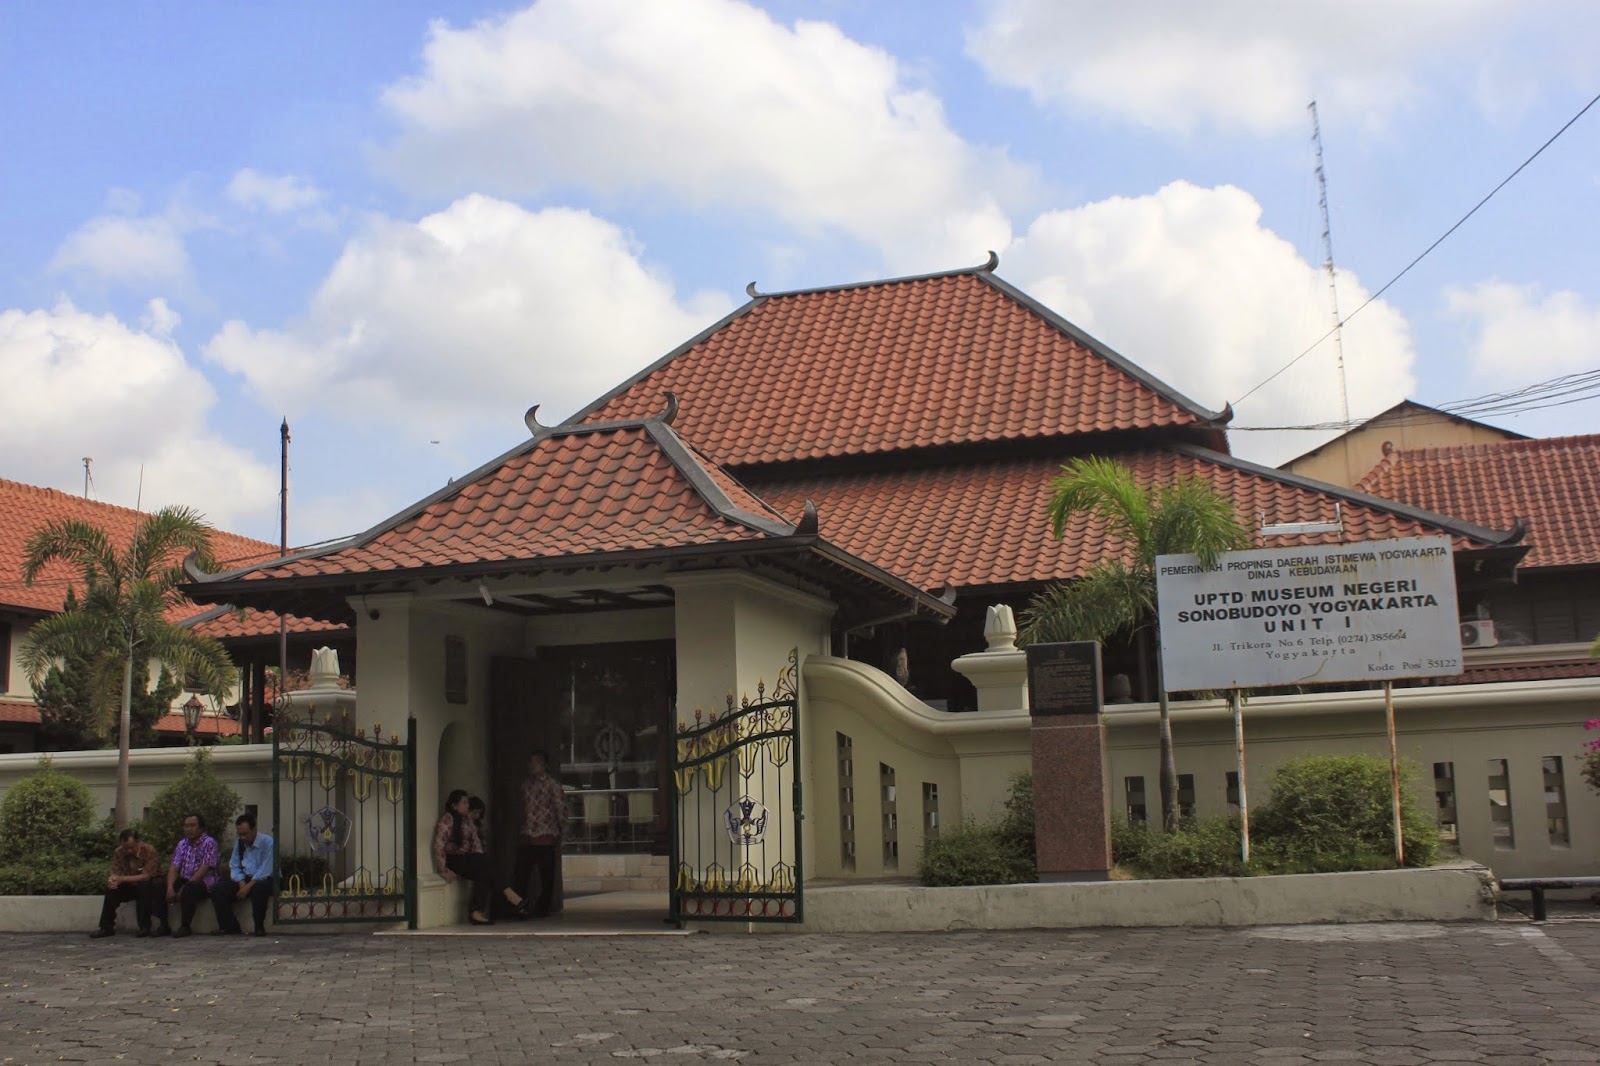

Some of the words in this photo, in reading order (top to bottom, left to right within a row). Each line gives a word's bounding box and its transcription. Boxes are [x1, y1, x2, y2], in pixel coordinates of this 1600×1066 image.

[1161, 563, 1222, 576] PEMERINAH
[1227, 559, 1273, 572] PROPINSI
[1277, 556, 1319, 568] DAERAH
[1325, 552, 1377, 564] ISTIMEWA
[1379, 547, 1447, 560] YOGYAKARTA
[1248, 569, 1280, 580] DINAS
[1289, 564, 1358, 577] KEBUDAYAAN
[1194, 592, 1244, 606] UPTD
[1251, 585, 1334, 603] MUSEUM
[1343, 579, 1417, 596] NEGERI
[1178, 604, 1301, 623] SONOBUDOYO
[1308, 595, 1438, 614] YOGYAKARTA
[1264, 618, 1324, 633] UNIT
[1345, 616, 1351, 629] I
[1230, 641, 1272, 651] Trikora
[1266, 648, 1356, 661] Yogyakarta
[1368, 663, 1395, 672] Kode
[1427, 659, 1457, 669] 55122
